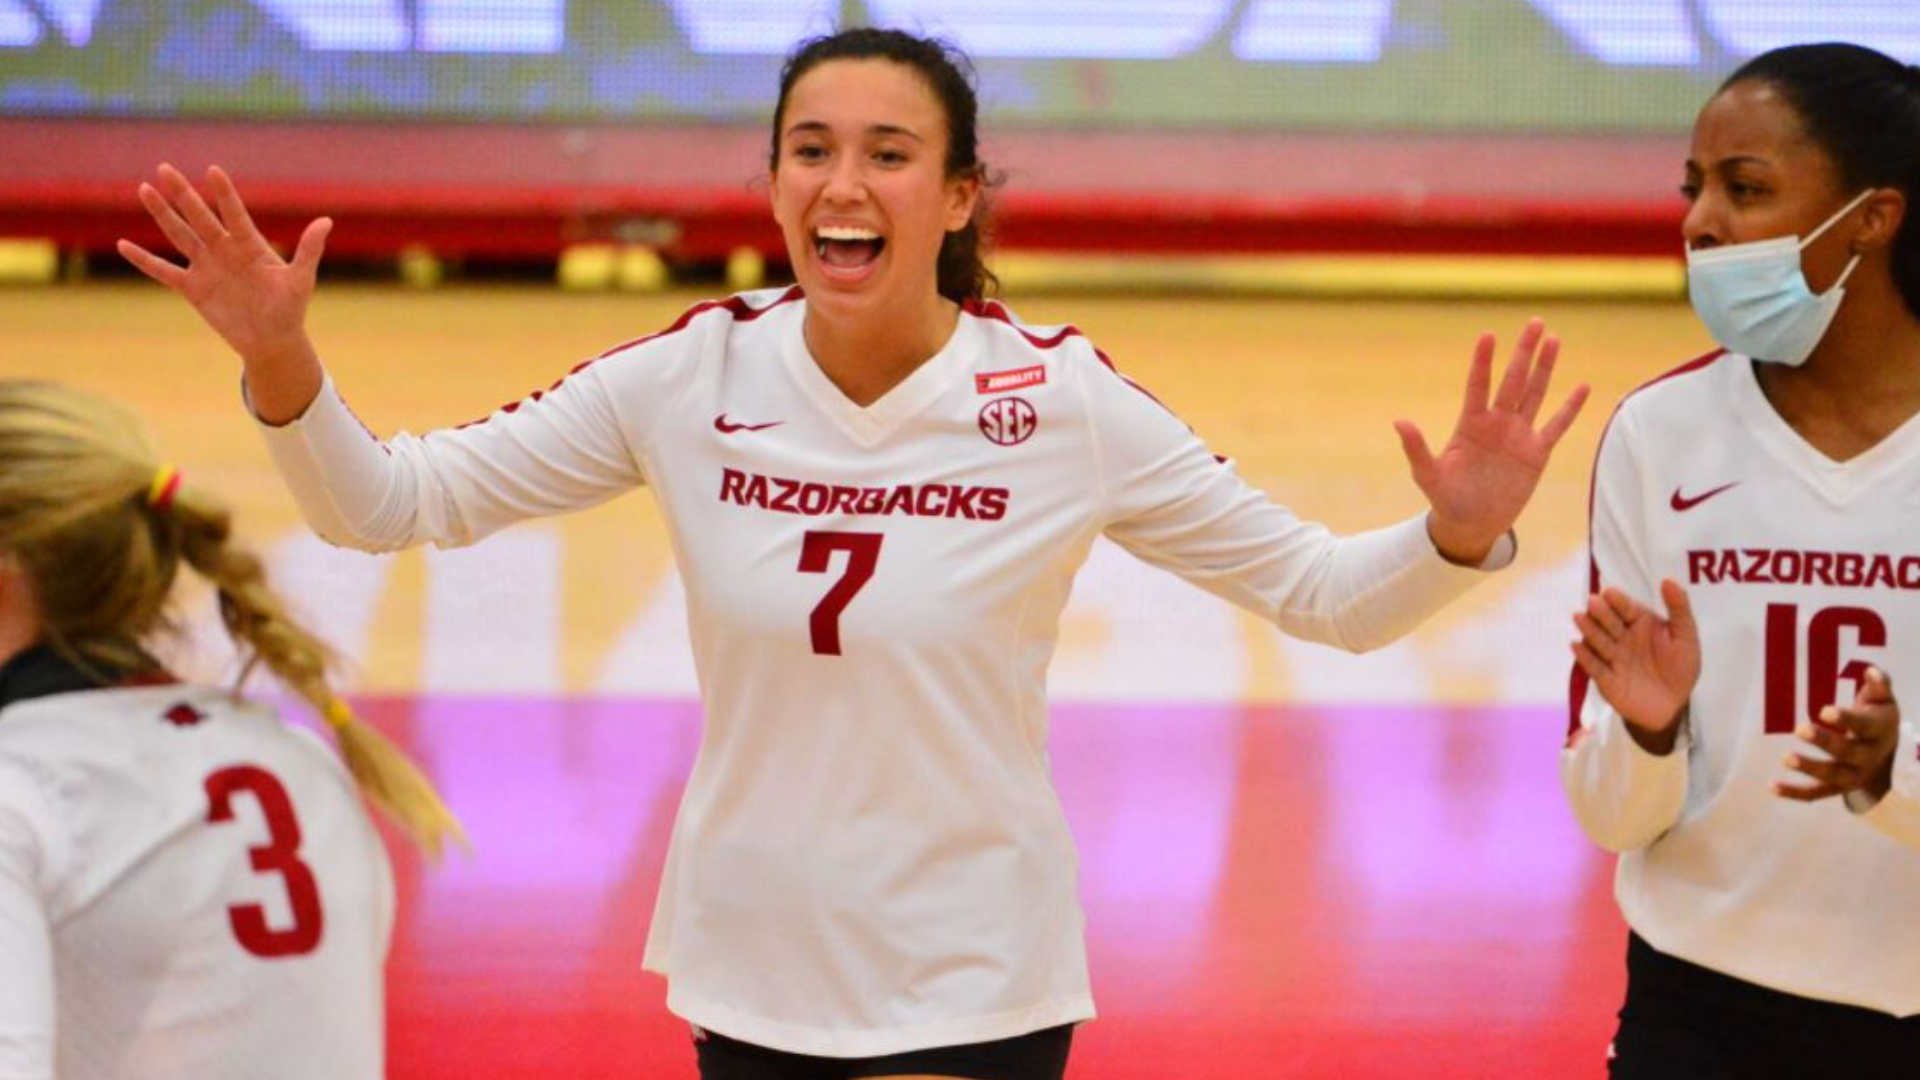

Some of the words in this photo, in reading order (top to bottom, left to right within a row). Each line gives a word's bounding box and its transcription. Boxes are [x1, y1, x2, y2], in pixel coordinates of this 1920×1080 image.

[979, 397, 1037, 446] SEC
[719, 467, 1010, 521] RAZORBACKS
[797, 530, 884, 656] 7
[1764, 602, 1887, 735] 16
[204, 764, 325, 959] 3
